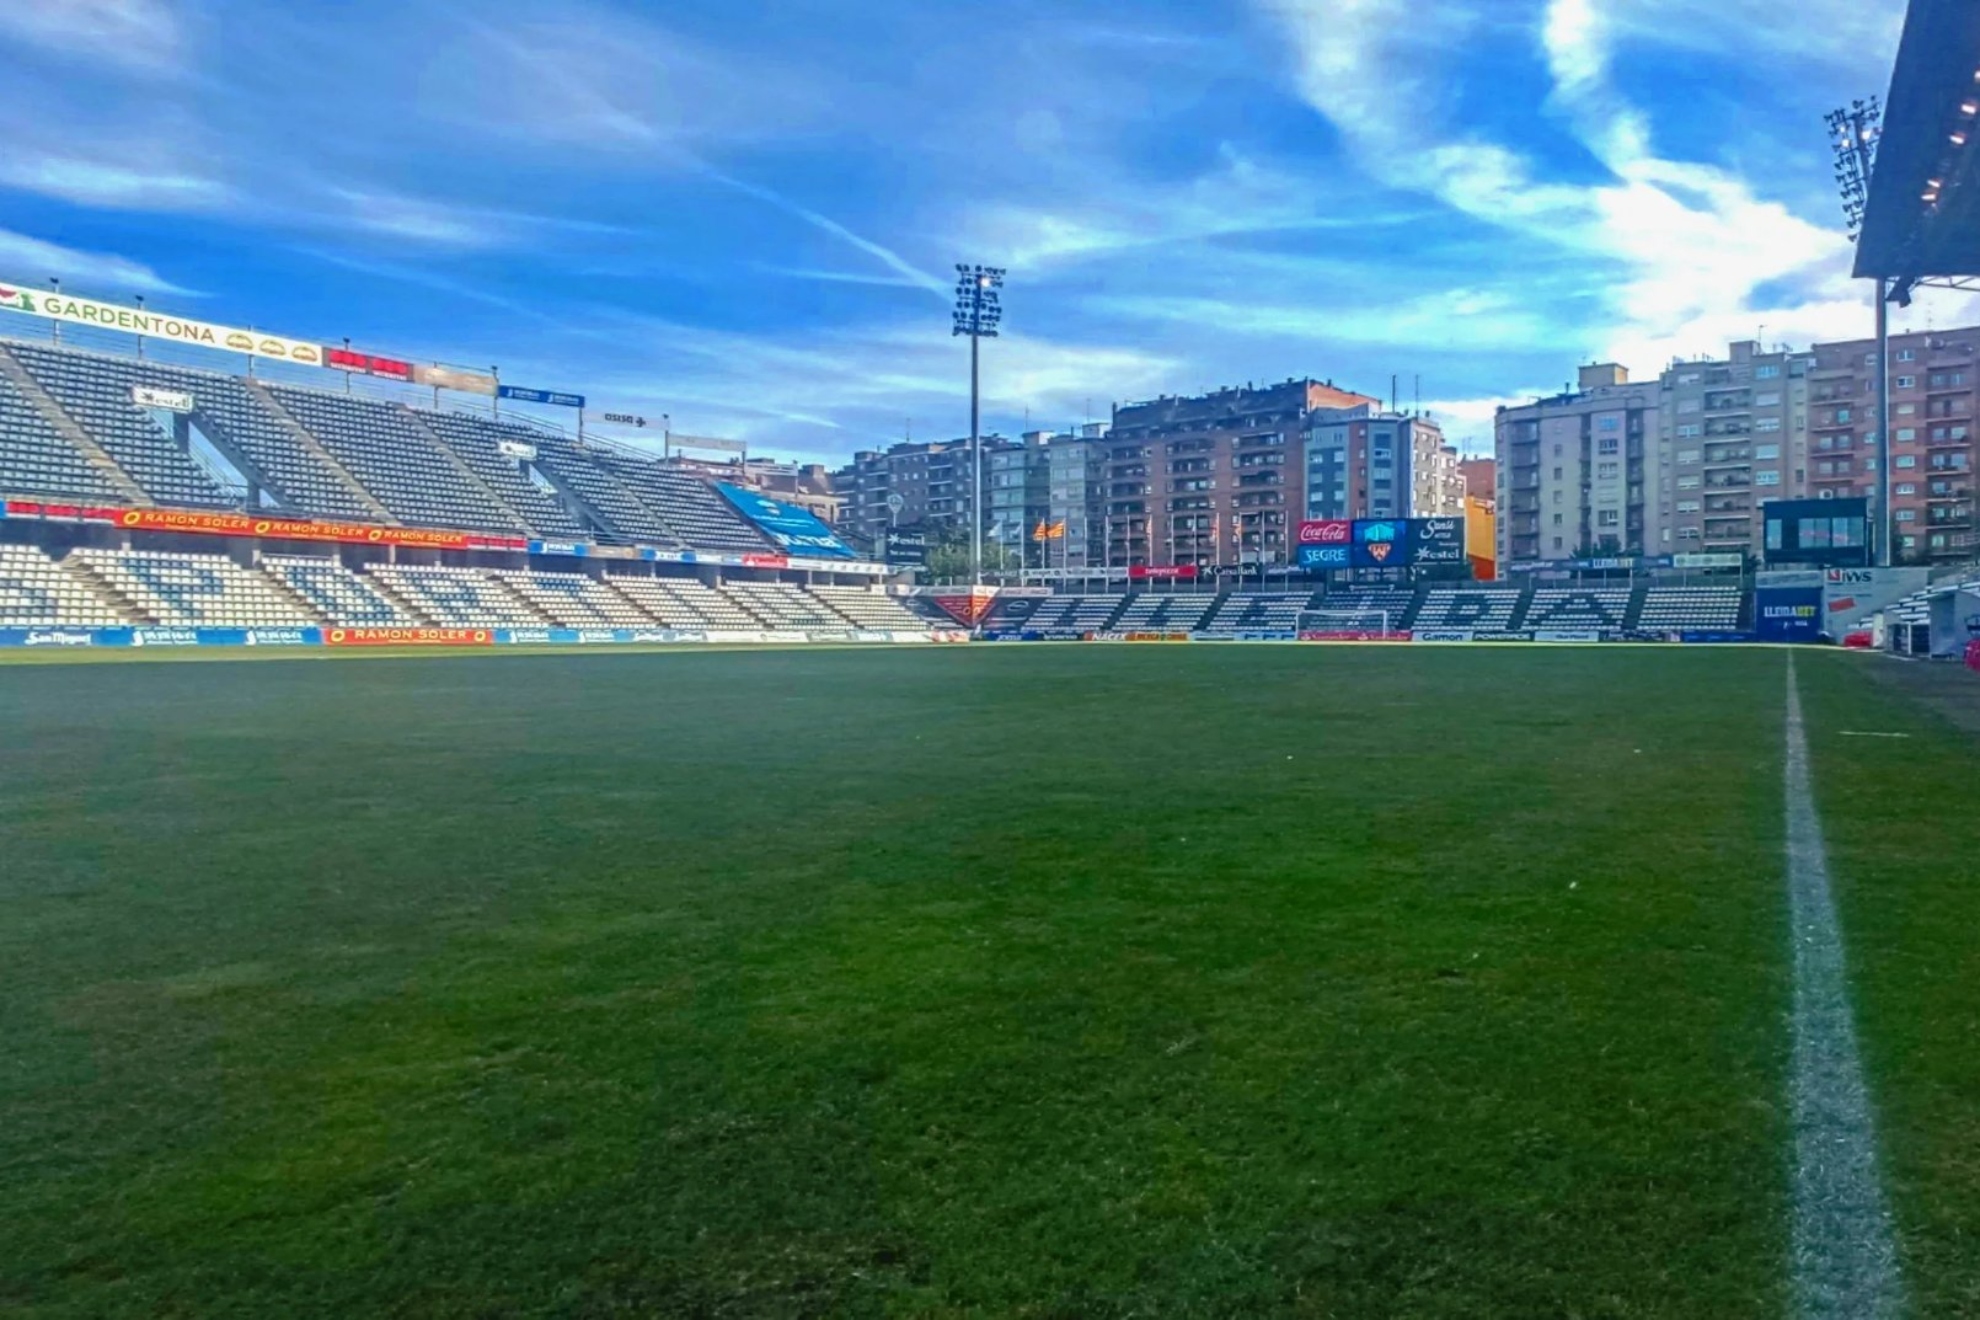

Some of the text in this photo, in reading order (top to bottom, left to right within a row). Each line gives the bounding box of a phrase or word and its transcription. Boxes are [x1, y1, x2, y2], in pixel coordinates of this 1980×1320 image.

[44, 297, 216, 344] GARDENTONA
[144, 513, 198, 526] RAMON
[203, 516, 250, 529] SOLER
[271, 522, 322, 535] RAMON
[323, 525, 364, 537] SOLER
[383, 530, 426, 542] RAMON
[427, 532, 463, 543] SOLER
[1303, 549, 1346, 563] SEGRE
[354, 629, 466, 639] RAMON SOLER
